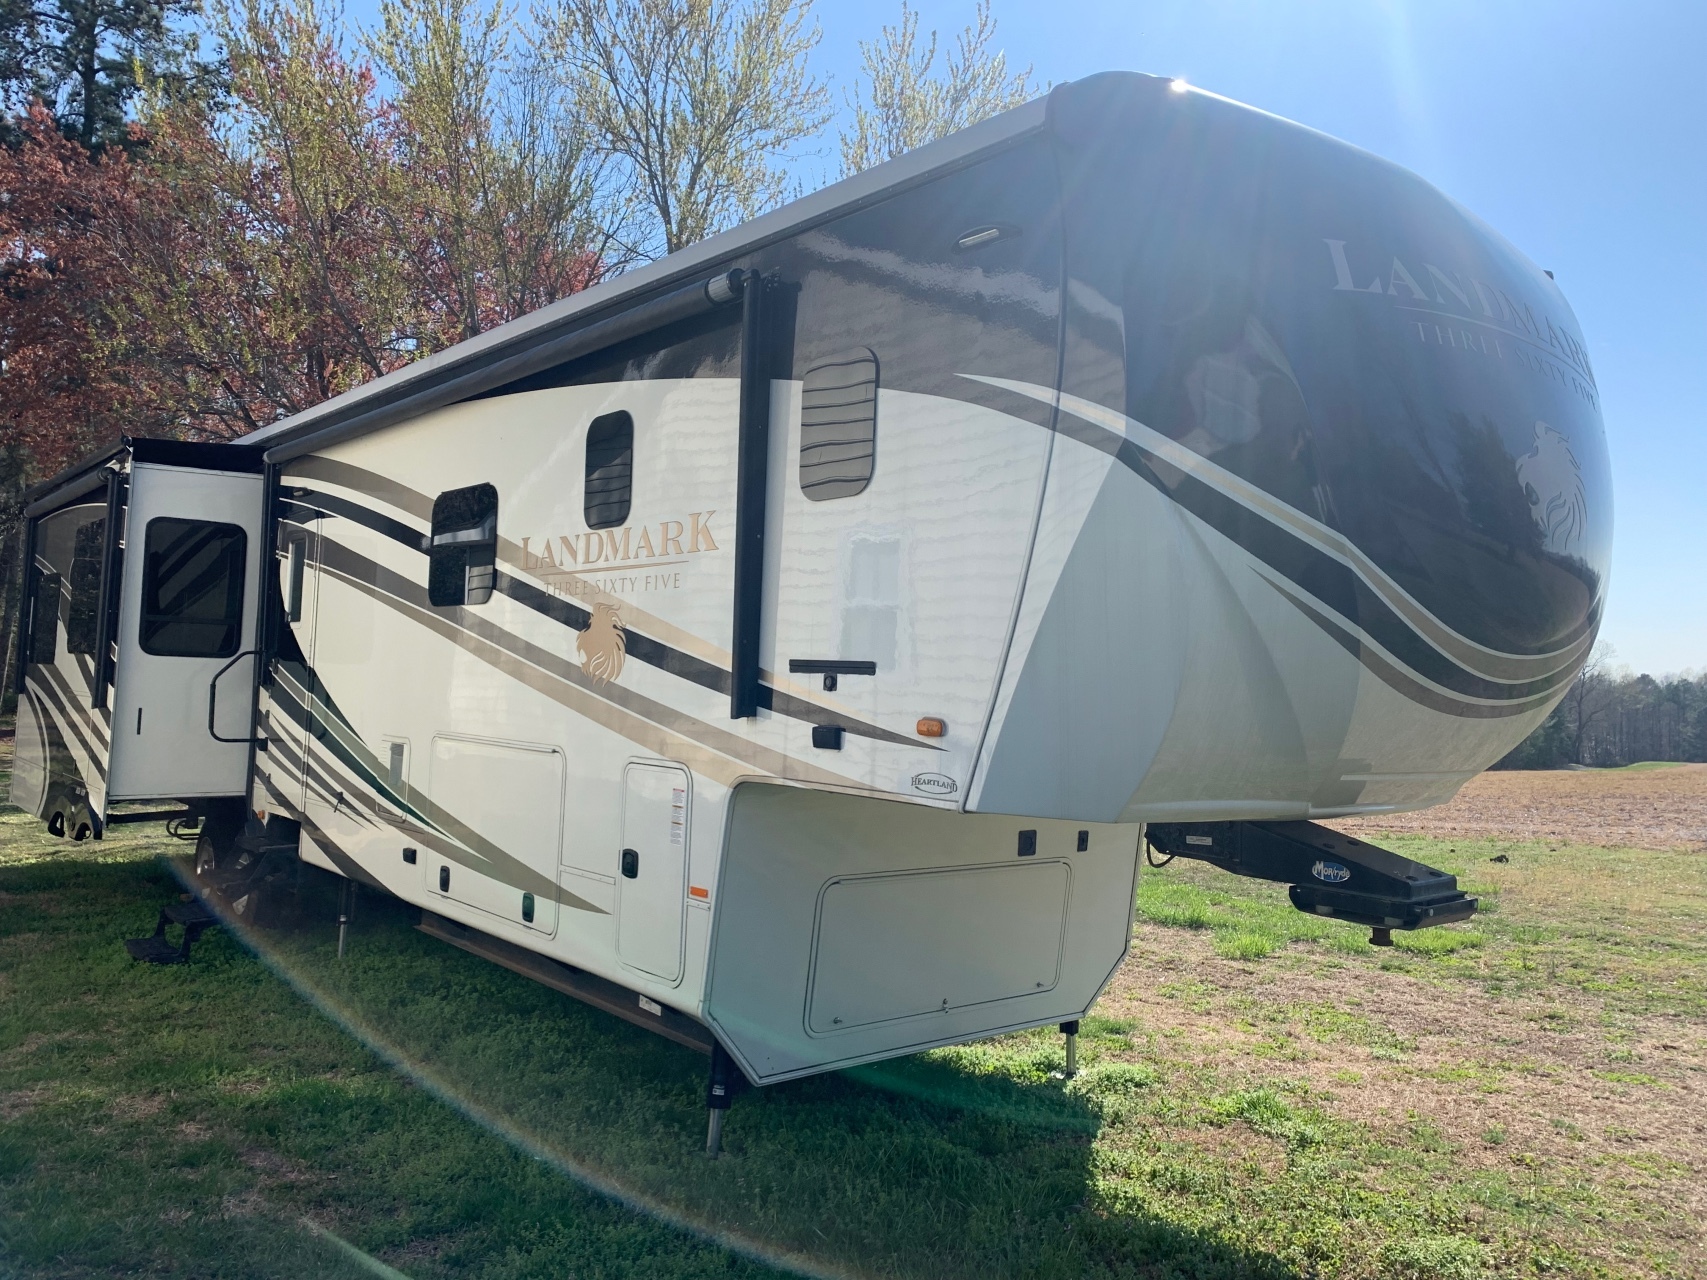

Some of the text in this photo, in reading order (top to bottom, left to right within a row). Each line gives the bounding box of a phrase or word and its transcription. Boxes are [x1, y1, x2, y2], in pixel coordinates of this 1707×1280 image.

[1514, 347, 1567, 387] SIXTY
[519, 509, 720, 571] LANDMARK
[544, 572, 681, 597] THREE SIXTY FIVE
[910, 776, 958, 793] HEARTLAND
